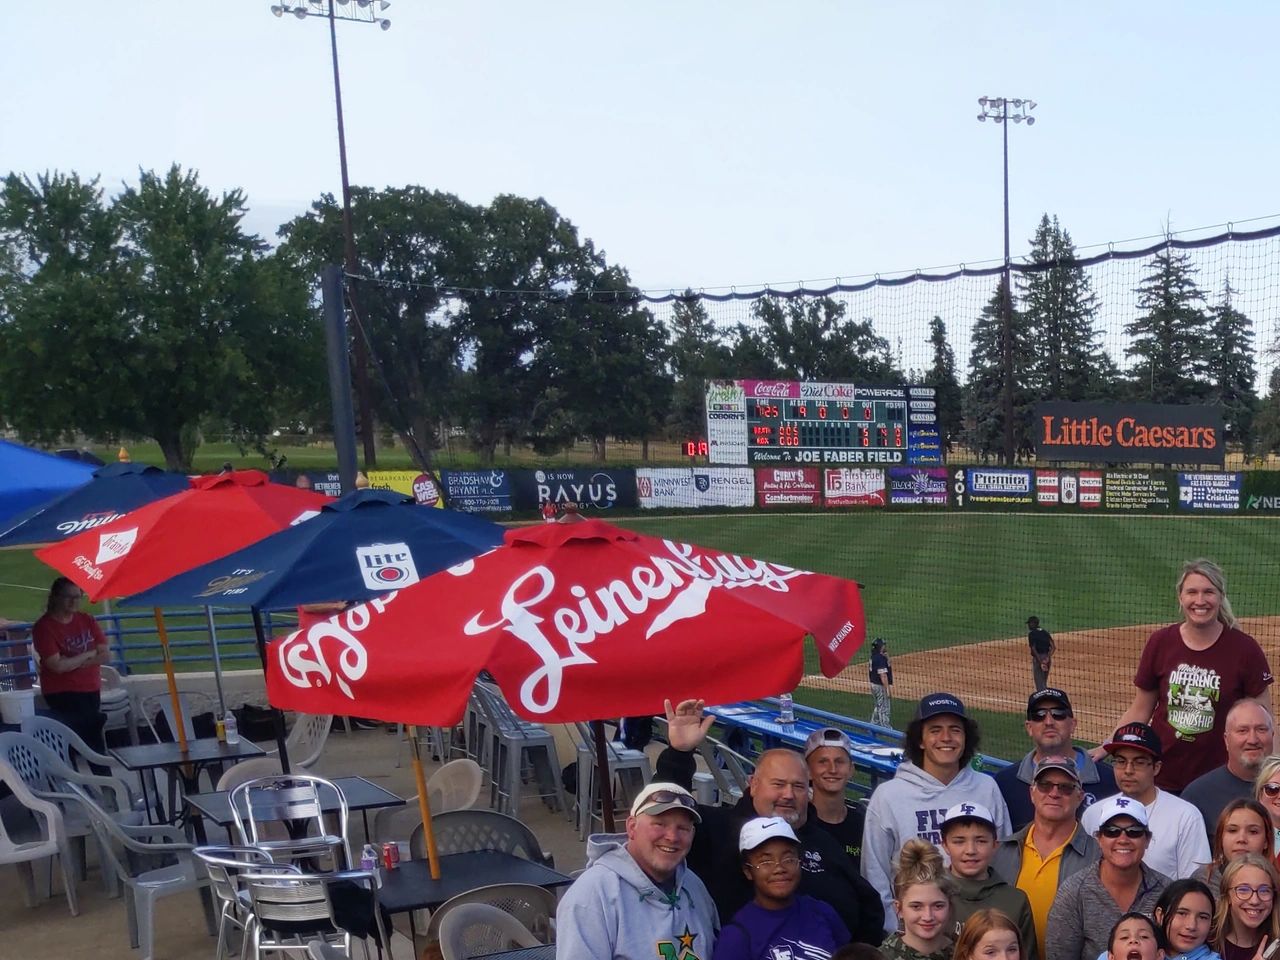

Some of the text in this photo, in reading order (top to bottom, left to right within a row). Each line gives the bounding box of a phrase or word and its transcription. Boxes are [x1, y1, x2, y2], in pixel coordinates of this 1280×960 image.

[801, 385, 853, 398] Diet Coke
[855, 388, 905, 397] POWERADE
[1042, 416, 1216, 449] Little Caesars
[754, 451, 780, 461] Welcome
[795, 451, 821, 462] JOE
[824, 451, 865, 462] FABER
[868, 451, 902, 463] FIELD
[845, 470, 863, 479] First
[975, 473, 1027, 485] Premier
[448, 476, 490, 485] BRADSHAW
[654, 477, 691, 487] MINNWEST
[711, 477, 752, 485] RENGEL
[449, 486, 479, 495] BRYANT
[845, 482, 867, 492] Bank
[537, 484, 617, 502] RAYUS
[654, 489, 676, 497] BANK
[363, 551, 408, 569] Lite
[1178, 663, 1208, 675] Making
[1169, 670, 1221, 690] DIFFERENCE
[928, 699, 958, 707] WIDSETH
[1169, 710, 1214, 728] FRIENDSHIP
